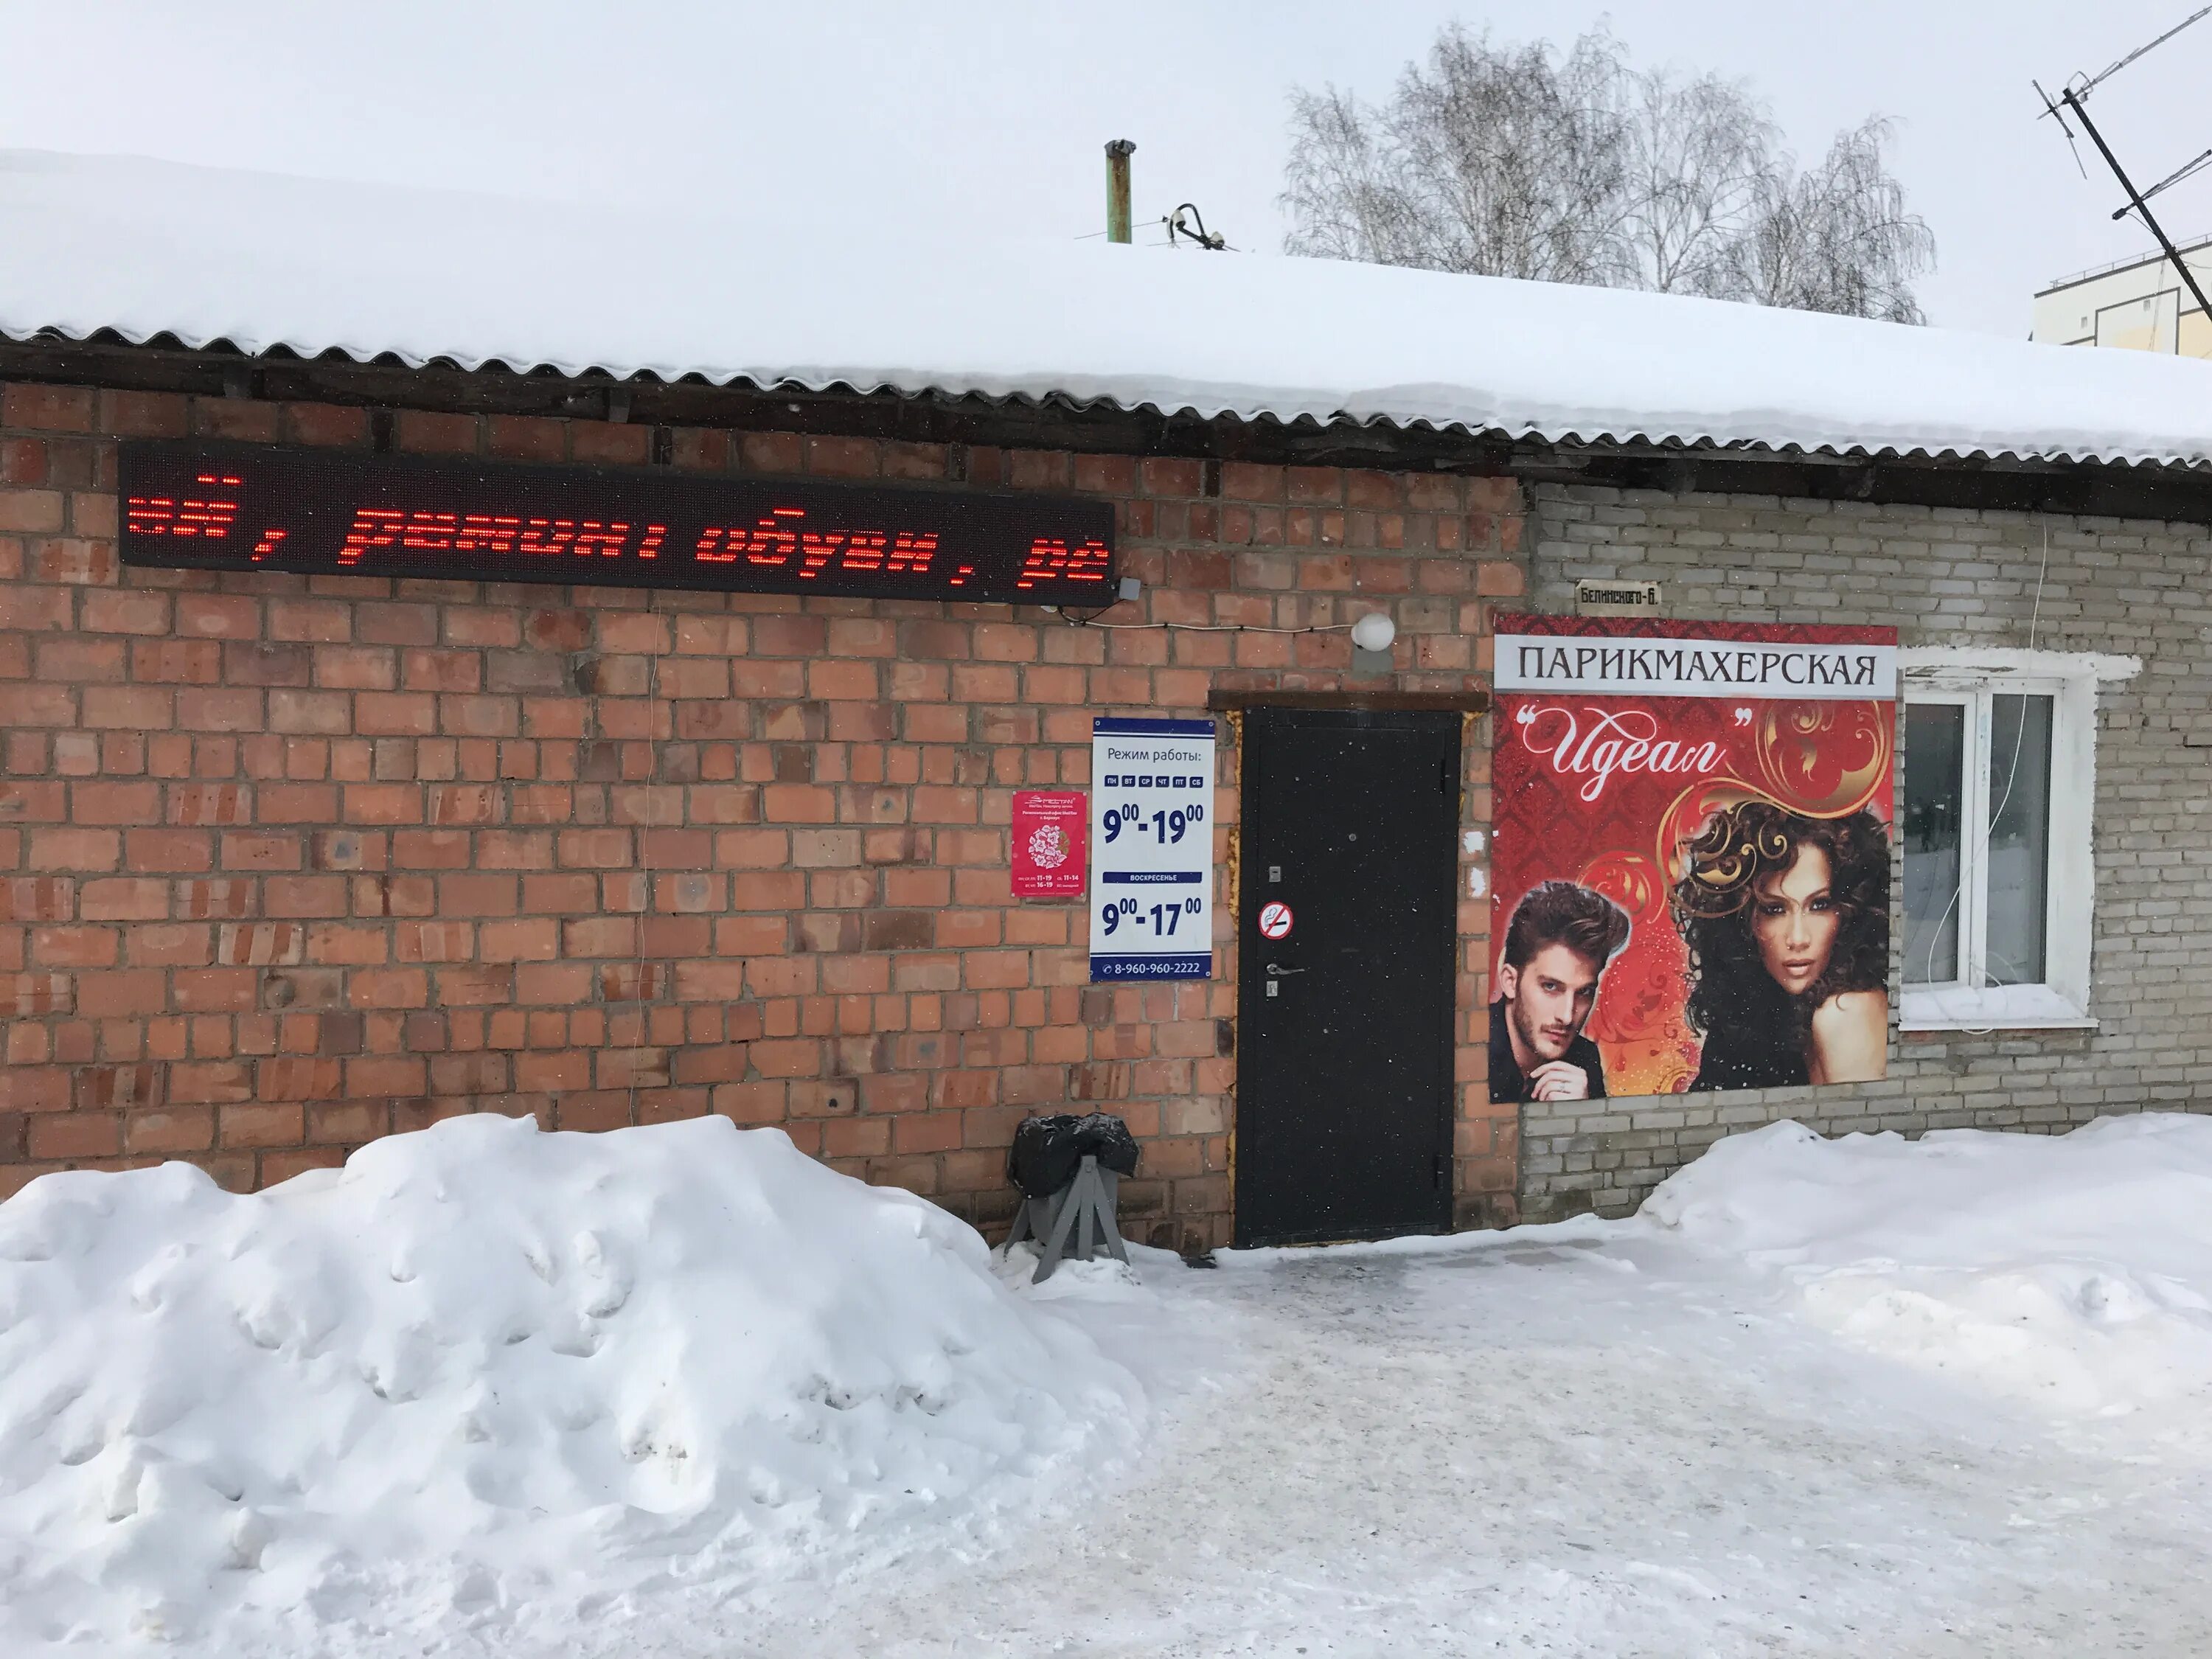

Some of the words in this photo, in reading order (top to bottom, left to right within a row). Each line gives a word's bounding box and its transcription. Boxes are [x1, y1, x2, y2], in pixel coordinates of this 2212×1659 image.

[1517, 645, 1877, 686] ПАРИКМАХЕРСКАЯ
[1107, 748, 1150, 760] Режим
[1153, 748, 1202, 763] работы:
[1130, 874, 1178, 882] ВОСКРЕСЕНЬЕ
[1114, 963, 1200, 974] 8-960-960-2222
